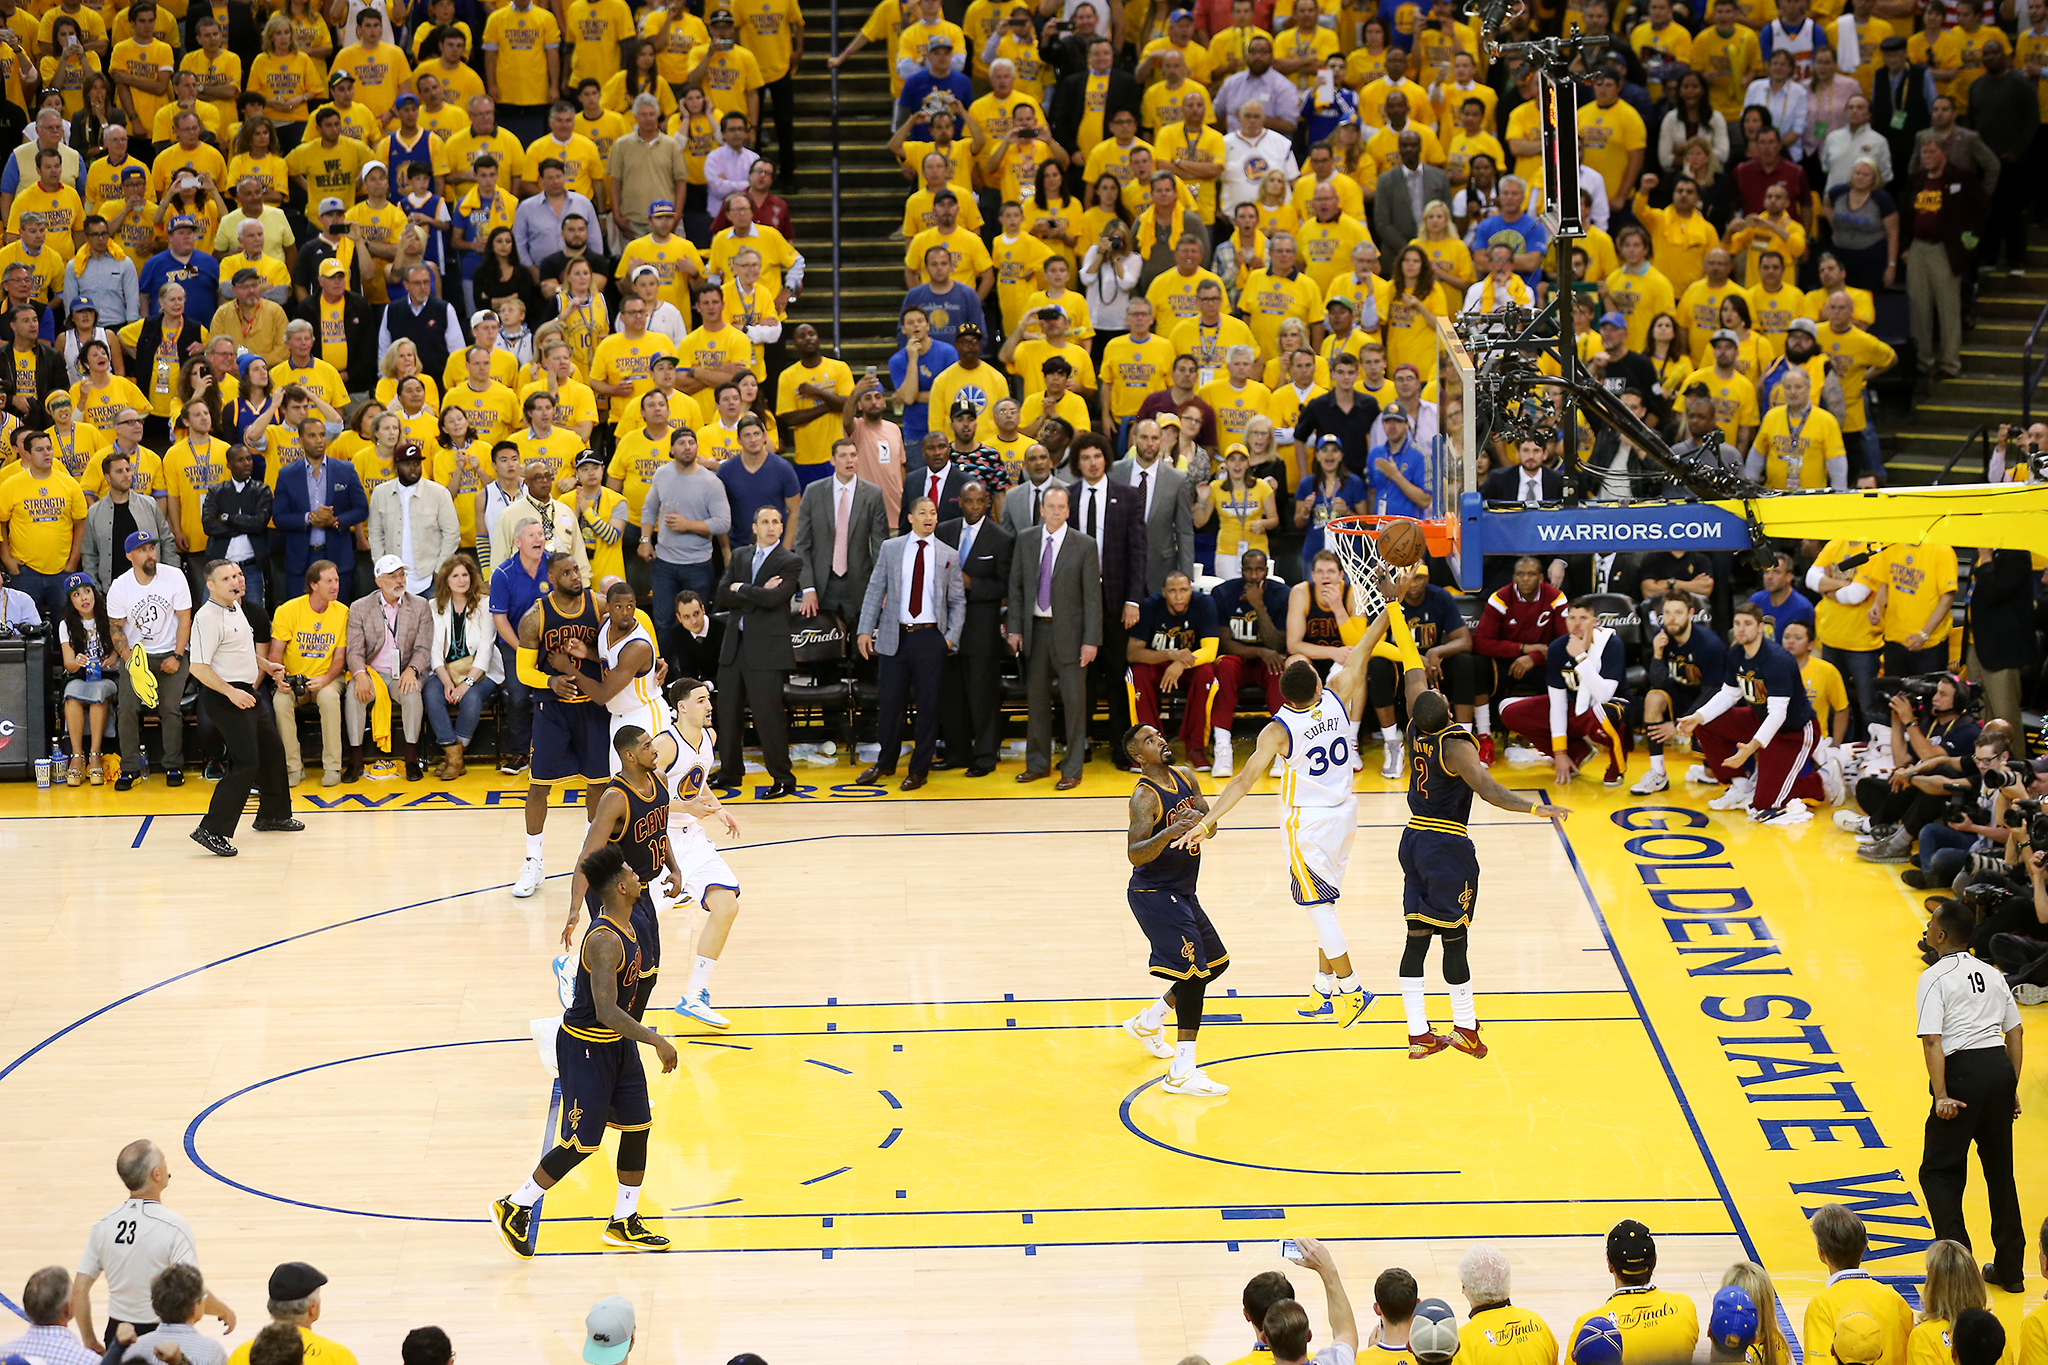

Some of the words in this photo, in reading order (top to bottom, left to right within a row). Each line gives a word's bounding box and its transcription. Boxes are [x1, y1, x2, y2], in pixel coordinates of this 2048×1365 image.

[465, 410, 498, 421] TRENGTH
[24, 497, 66, 510] STRENGTH
[1537, 521, 1723, 542] WARRIORS.COM
[1307, 618, 1339, 637] CAV
[1536, 610, 1551, 627] C
[1596, 611, 1642, 627] Finals
[296, 631, 336, 644] STRENGTH
[801, 628, 845, 647] Finals
[1304, 717, 1340, 741] CURRY
[1305, 736, 1350, 777] 30
[1413, 755, 1429, 800] 2
[302, 783, 889, 810] WARRORS
[1611, 806, 1793, 977] GOLDEN
[1967, 971, 1986, 994] 19
[1700, 995, 1892, 1151] STATE
[115, 1220, 137, 1245] 23
[1632, 1302, 1678, 1326] Finals
[1643, 1320, 1659, 1329] 2015
[1505, 1318, 1542, 1341] Finals
[1515, 1334, 1528, 1344] 2015
